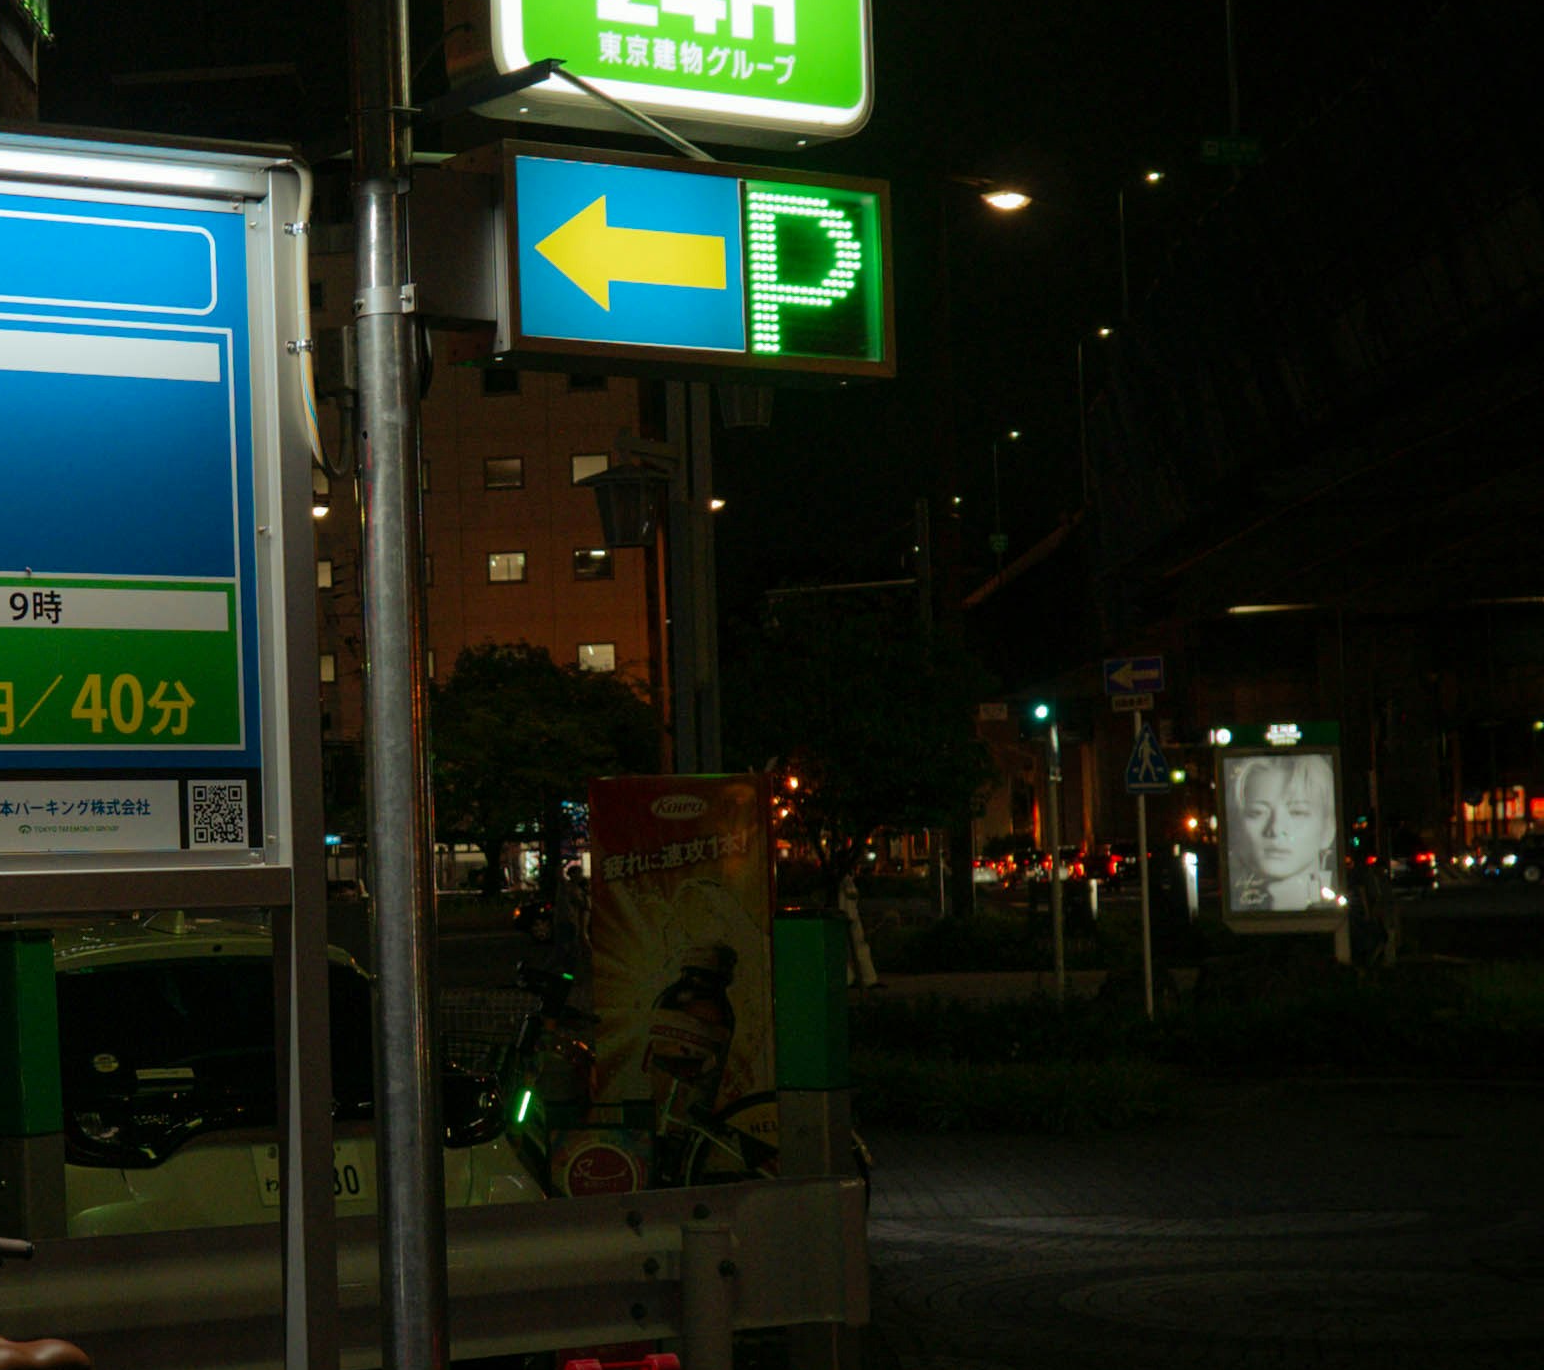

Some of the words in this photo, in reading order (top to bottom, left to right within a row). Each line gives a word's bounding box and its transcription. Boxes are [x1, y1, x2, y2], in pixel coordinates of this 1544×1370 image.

[597, 31, 796, 86] 東京建物グループ
[749, 190, 862, 355] P
